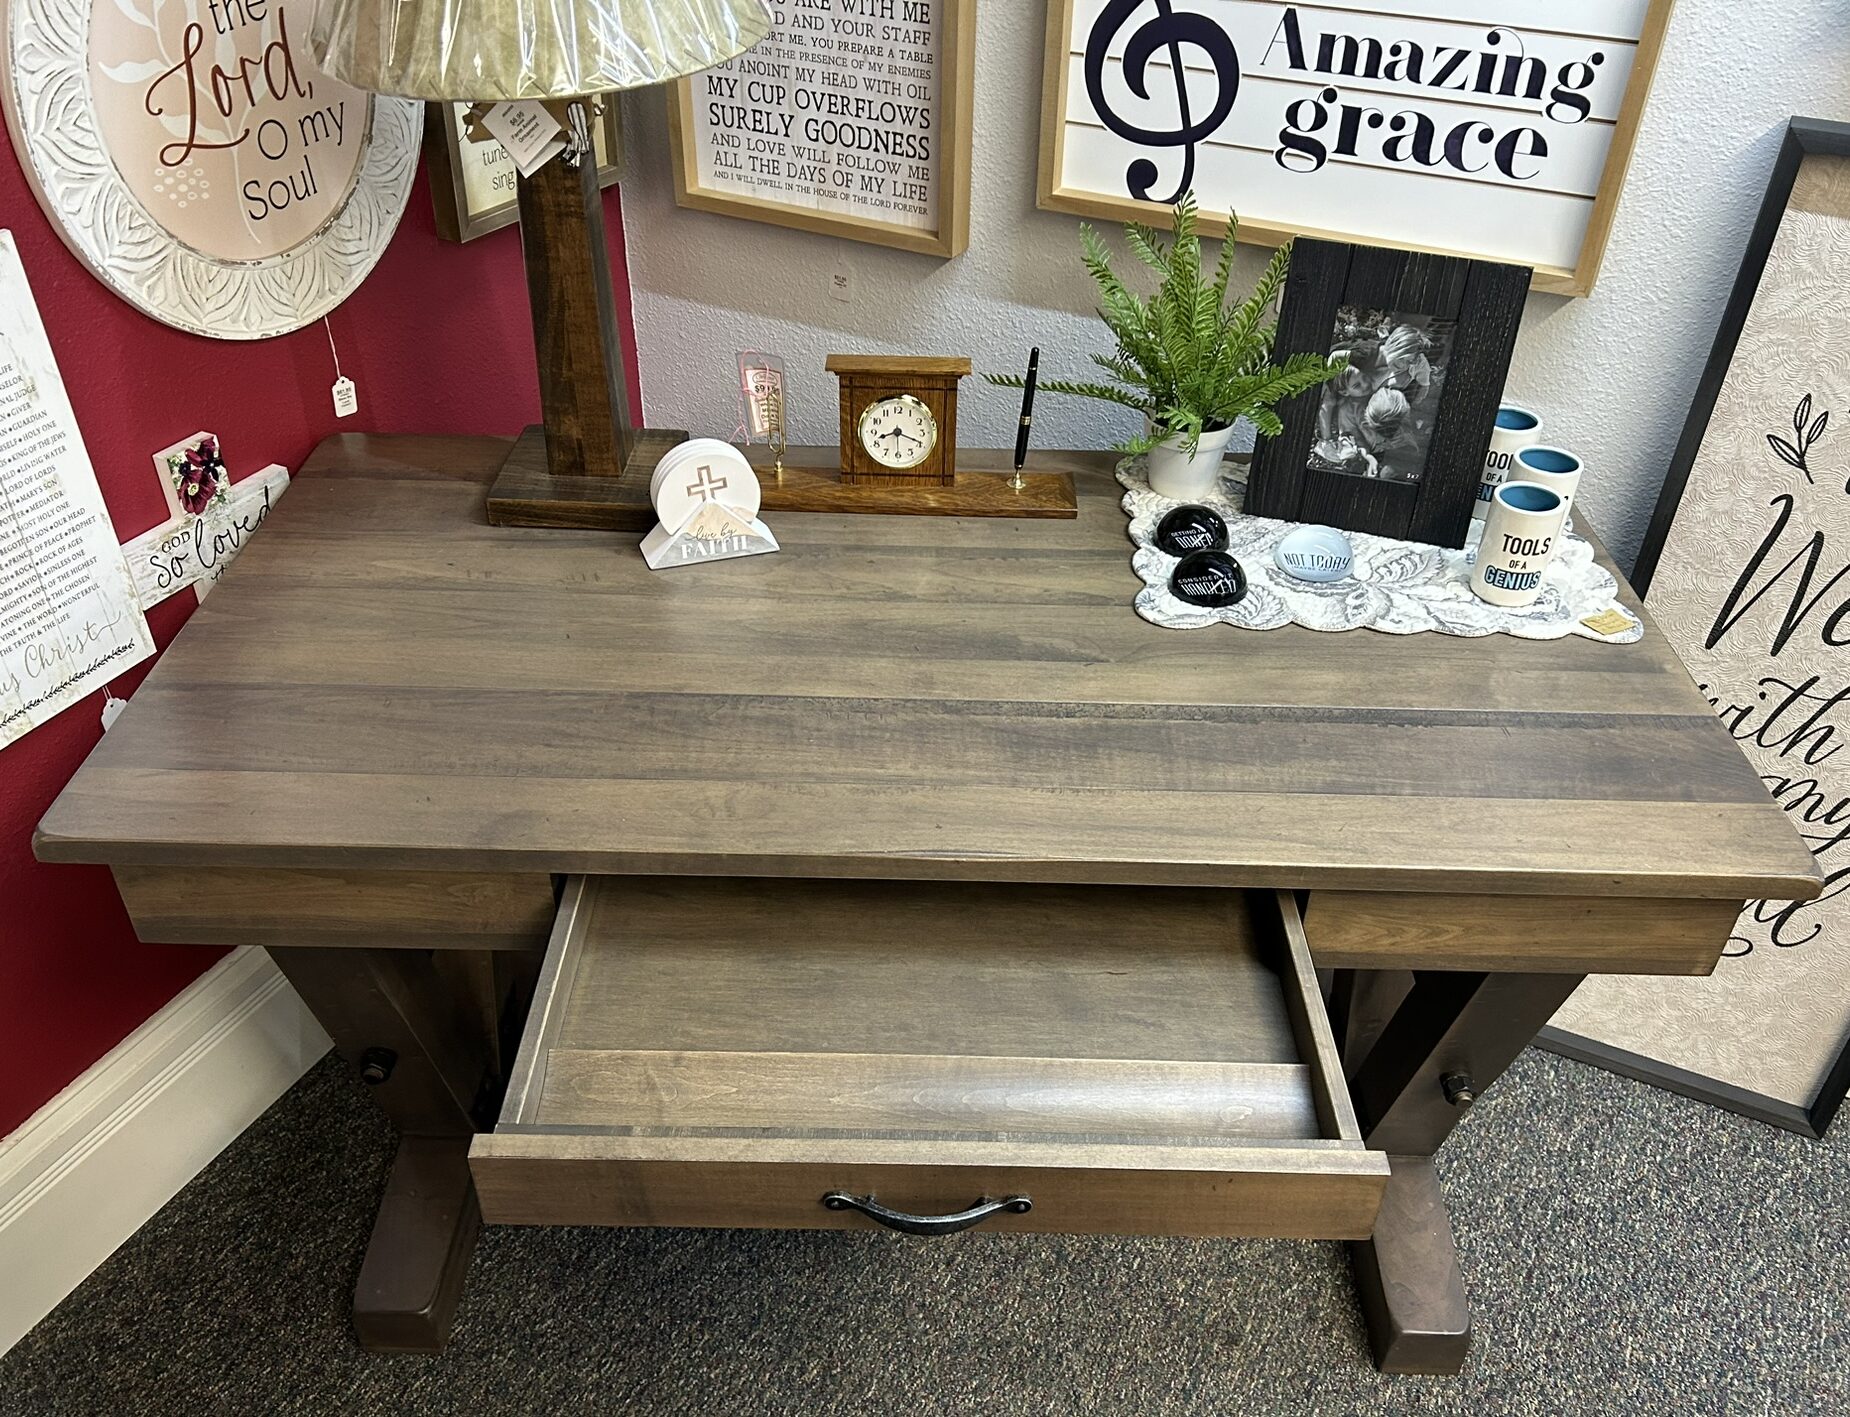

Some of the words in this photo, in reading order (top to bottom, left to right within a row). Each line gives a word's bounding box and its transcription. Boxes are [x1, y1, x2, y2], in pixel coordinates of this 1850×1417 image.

[209, 0, 268, 35] the
[841, 0, 896, 20] WITH
[902, 2, 931, 25] ME
[791, 13, 825, 31] AND
[831, 18, 876, 39] YOUR
[882, 25, 932, 47] STAFF
[761, 46, 772, 55] IN
[776, 48, 795, 59] THE
[800, 51, 847, 67] PRESENCE
[851, 58, 865, 70] OF
[868, 61, 883, 73] MY
[888, 65, 931, 80] ENEMIES
[789, 34, 807, 47] ME.
[811, 37, 833, 49] YOU
[838, 41, 883, 57] PREPARE
[888, 48, 895, 59] A
[899, 49, 933, 64] TABLE
[1260, 6, 1605, 125] Amazing
[146, 6, 313, 167] Lord,
[739, 60, 789, 79] ANOINT
[795, 67, 816, 83] MY
[821, 71, 857, 90] HEAD
[862, 77, 901, 97] WITH
[906, 83, 931, 101] OIL
[707, 75, 739, 98] MY
[747, 80, 786, 105] CUP
[794, 88, 931, 130] OVERFLOWS
[258, 119, 288, 160] O
[298, 101, 345, 146] my
[709, 102, 795, 138] SURELY
[804, 117, 930, 162] GOODNESS
[1273, 86, 1549, 181] grace
[710, 132, 741, 148] AND
[746, 138, 786, 157] LOVE
[791, 145, 831, 164] WILL
[836, 153, 902, 175] FOLLOW
[907, 165, 930, 182] ME
[492, 171, 515, 190] sing
[713, 150, 743, 170] ALL
[748, 154, 781, 176] THE
[786, 161, 827, 184] DAYS
[833, 169, 854, 189] OF
[860, 174, 885, 195] MY
[892, 181, 928, 202] LIFE
[713, 170, 729, 180] AND
[730, 173, 734, 181] I
[735, 174, 753, 184] WILL
[757, 177, 783, 190] DWELL
[785, 182, 794, 191] IN
[795, 184, 812, 196] THE
[813, 187, 838, 200] HOUSE
[840, 191, 851, 202] OF
[852, 193, 868, 205] THE
[870, 196, 892, 209] LORD
[893, 199, 929, 216] FOREVER
[14, 384, 37, 402] JUDGE
[11, 402, 32, 416] GIVER
[12, 409, 48, 431] GUARDIAN
[883, 409, 889, 417] 11
[894, 406, 903, 414] 12
[22, 428, 41, 441] HOLY
[41, 420, 57, 432] ONE
[873, 440, 880, 448] 8
[920, 429, 925, 437] 3
[12, 448, 28, 461] KING
[28, 444, 37, 453] OF
[37, 438, 50, 449] THE
[50, 431, 66, 445] JEWS
[43, 445, 67, 460] WATER
[895, 451, 902, 459] 6
[907, 448, 914, 456] 5
[5, 481, 23, 494] LORD
[24, 476, 33, 485] OF
[34, 465, 56, 480] LORDS
[43, 479, 57, 490] SON
[1486, 472, 1496, 481] OF
[1497, 475, 1502, 483] A
[29, 491, 64, 512] MEDIATOR
[17, 518, 36, 532] MOST
[37, 509, 55, 523] HOLY
[56, 501, 71, 513] ONE
[35, 527, 50, 539] SON
[53, 517, 68, 529] OUR
[67, 507, 86, 521] HEAD
[195, 485, 271, 569] loved
[8, 549, 34, 566] PRINCE
[34, 545, 43, 553] OF
[44, 532, 64, 548] PEACE
[67, 515, 97, 535] PROPHET
[161, 531, 191, 553] GOD
[681, 535, 747, 559] FAITH
[696, 525, 717, 541] live
[1171, 529, 1196, 537] GETTING
[1502, 534, 1552, 556] TOOLS
[14, 562, 34, 577] ROCK
[39, 551, 57, 565] ROCK
[57, 545, 67, 555] OF
[67, 536, 84, 550] AGES
[17, 573, 43, 590] SAVIOR
[47, 557, 71, 574] SINLESS
[72, 549, 86, 561] ONE
[1284, 553, 1305, 567] NOT
[1310, 554, 1351, 569] TODAY
[1509, 559, 1520, 569] OF
[1520, 561, 1527, 570] A
[32, 584, 48, 596] SON
[47, 579, 57, 588] OF
[57, 572, 70, 583] THE
[70, 556, 98, 575] HIGHEST
[1178, 575, 1219, 584] CONSIDER
[1181, 579, 1236, 596] HANDLED
[1484, 565, 1541, 591] GENIUS
[0, 606, 31, 628] ATONING
[31, 598, 46, 610] ONE
[51, 588, 65, 600] THE
[65, 574, 91, 591] CHOSEN
[0, 629, 18, 642] VINE
[23, 618, 36, 630] THE
[37, 606, 58, 621] WORD
[0, 645, 13, 657] THE
[13, 632, 36, 648] TRUTH
[42, 620, 56, 633] THE
[56, 612, 71, 624] LIFE
[24, 610, 121, 679] Christ
